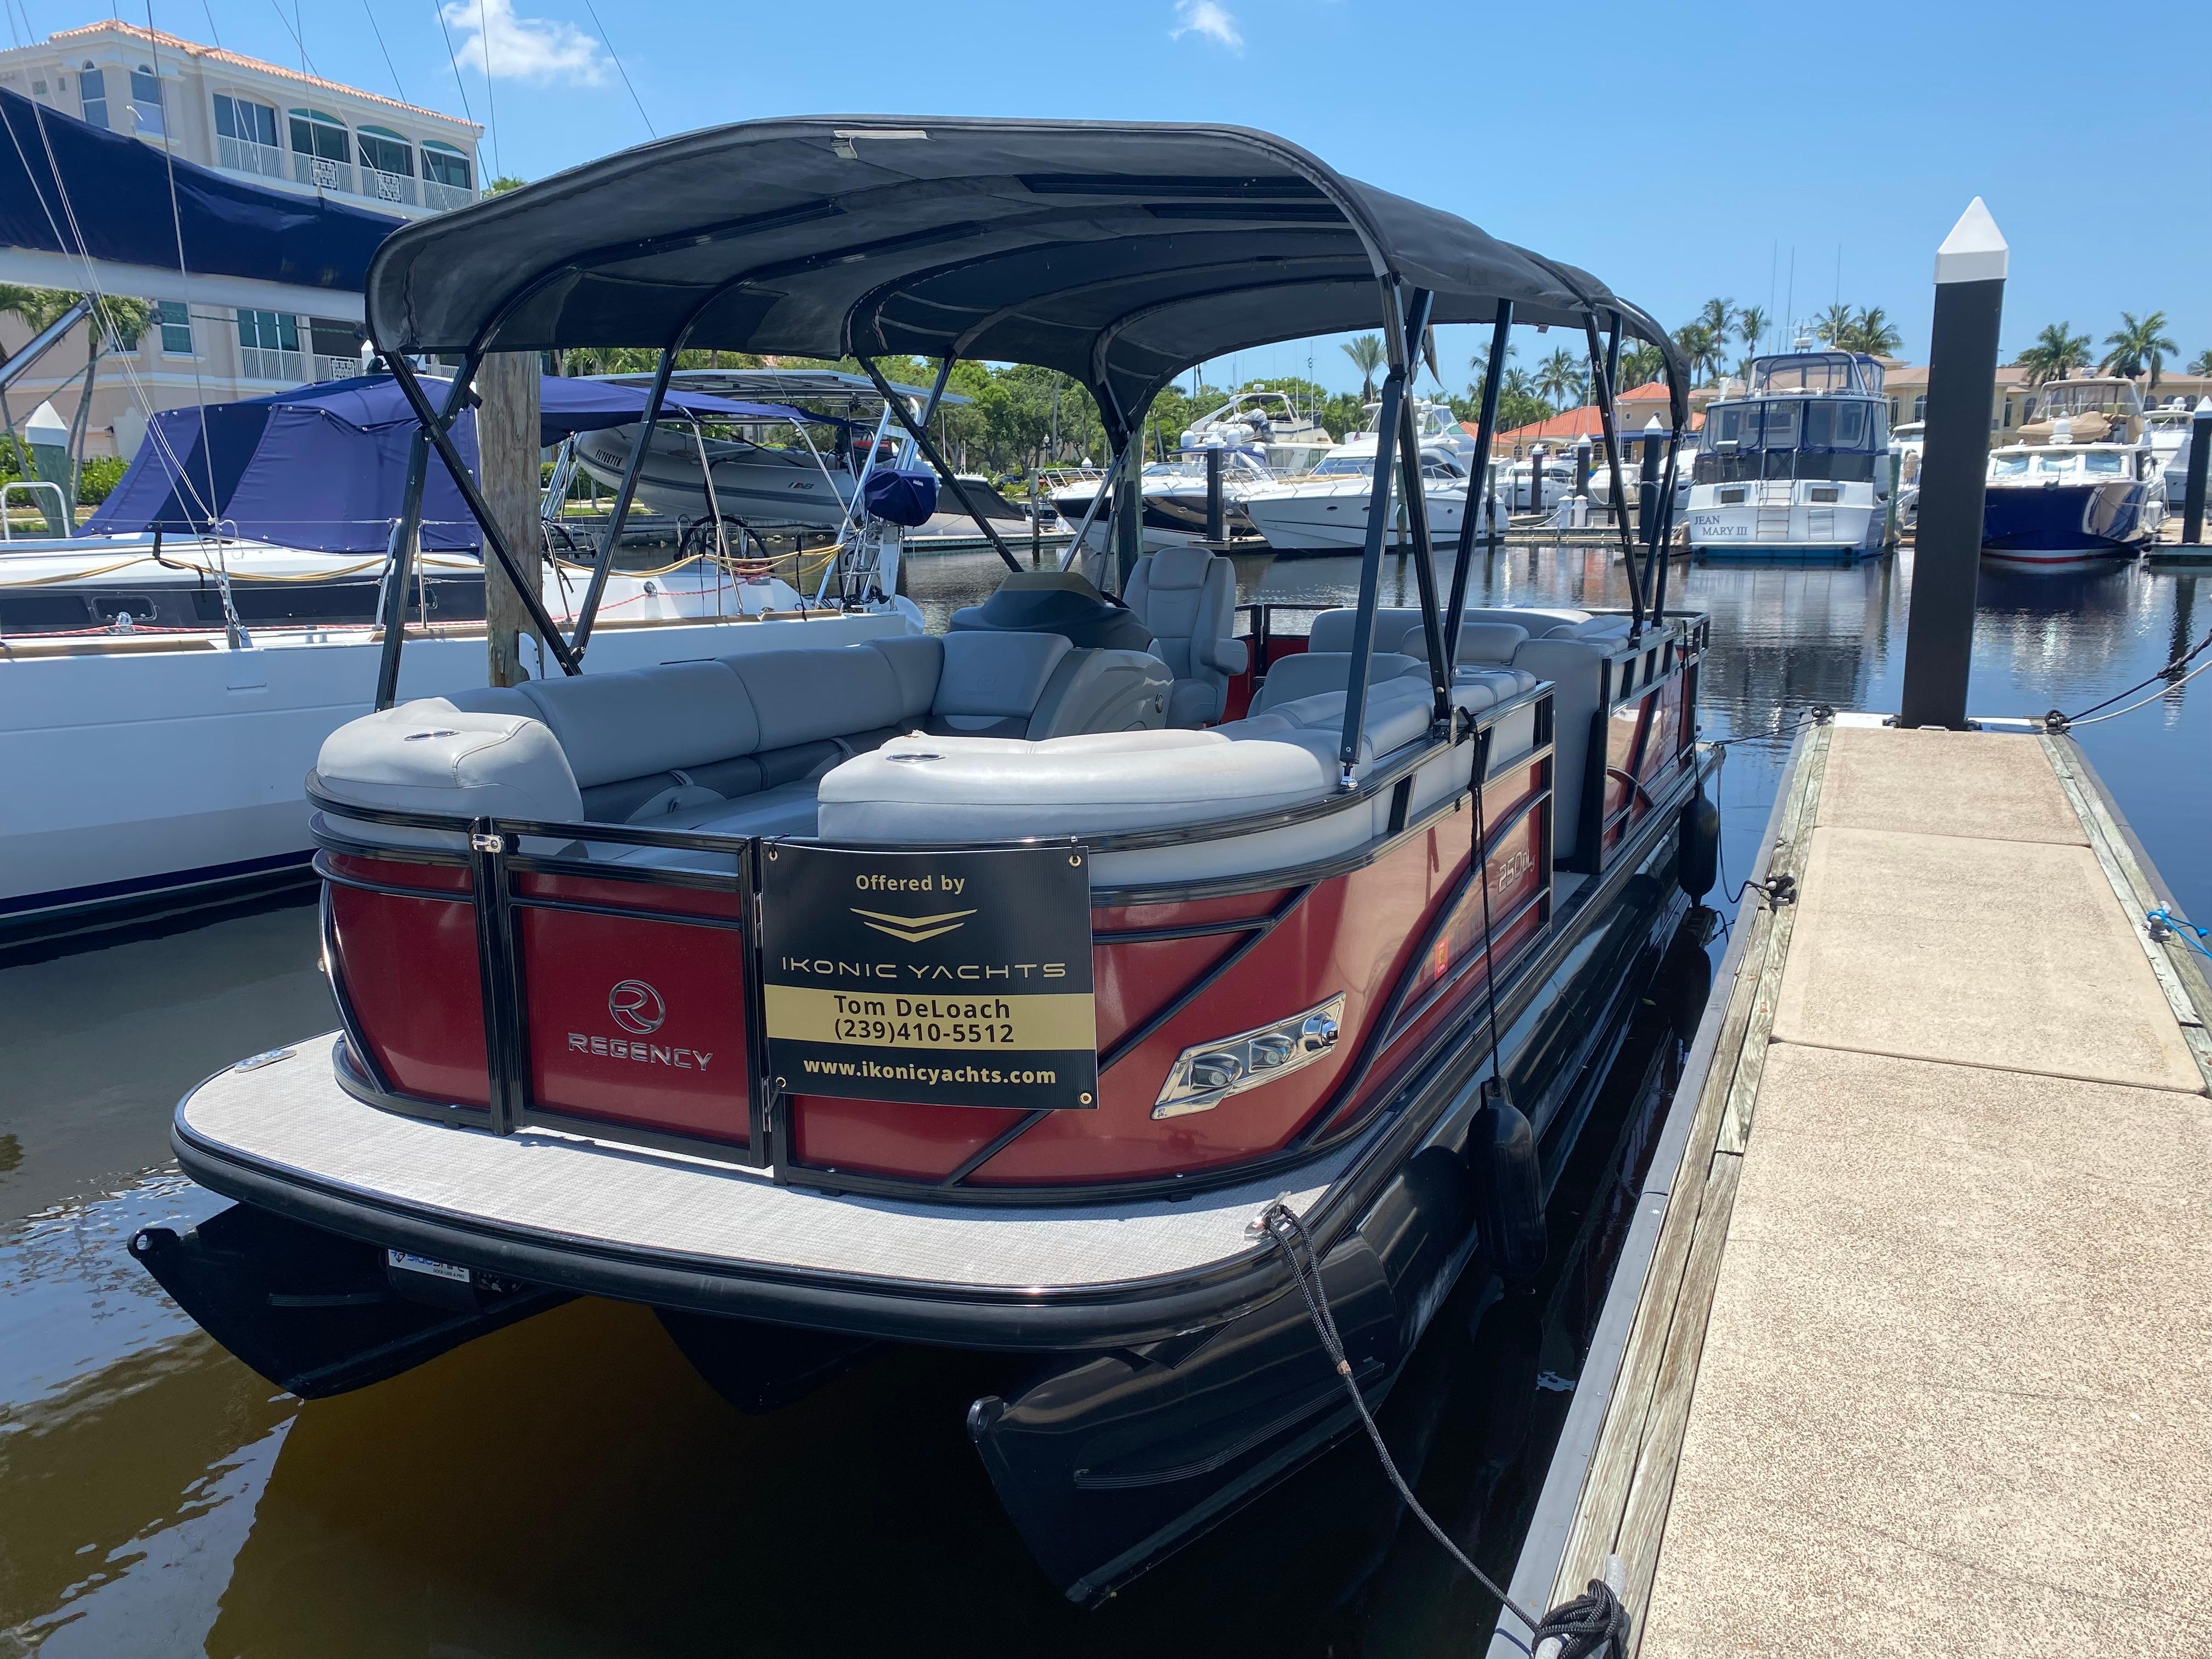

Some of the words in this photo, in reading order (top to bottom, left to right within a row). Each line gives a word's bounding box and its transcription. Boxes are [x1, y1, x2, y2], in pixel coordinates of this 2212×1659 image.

[1694, 515, 1720, 526] JEAN
[1702, 526, 1735, 536] MARY
[1736, 526, 1747, 536] III
[855, 874, 933, 891] Offered
[941, 875, 966, 895] by
[782, 957, 898, 979] IKONIC
[908, 962, 1066, 980] YACHTS
[833, 995, 886, 1017] Tom
[896, 998, 1011, 1019] DeLoach
[834, 1019, 1014, 1044] (239)410-5512
[568, 1032, 713, 1071] REGENCY
[803, 1059, 1057, 1086] www.ikonicyachts.com
